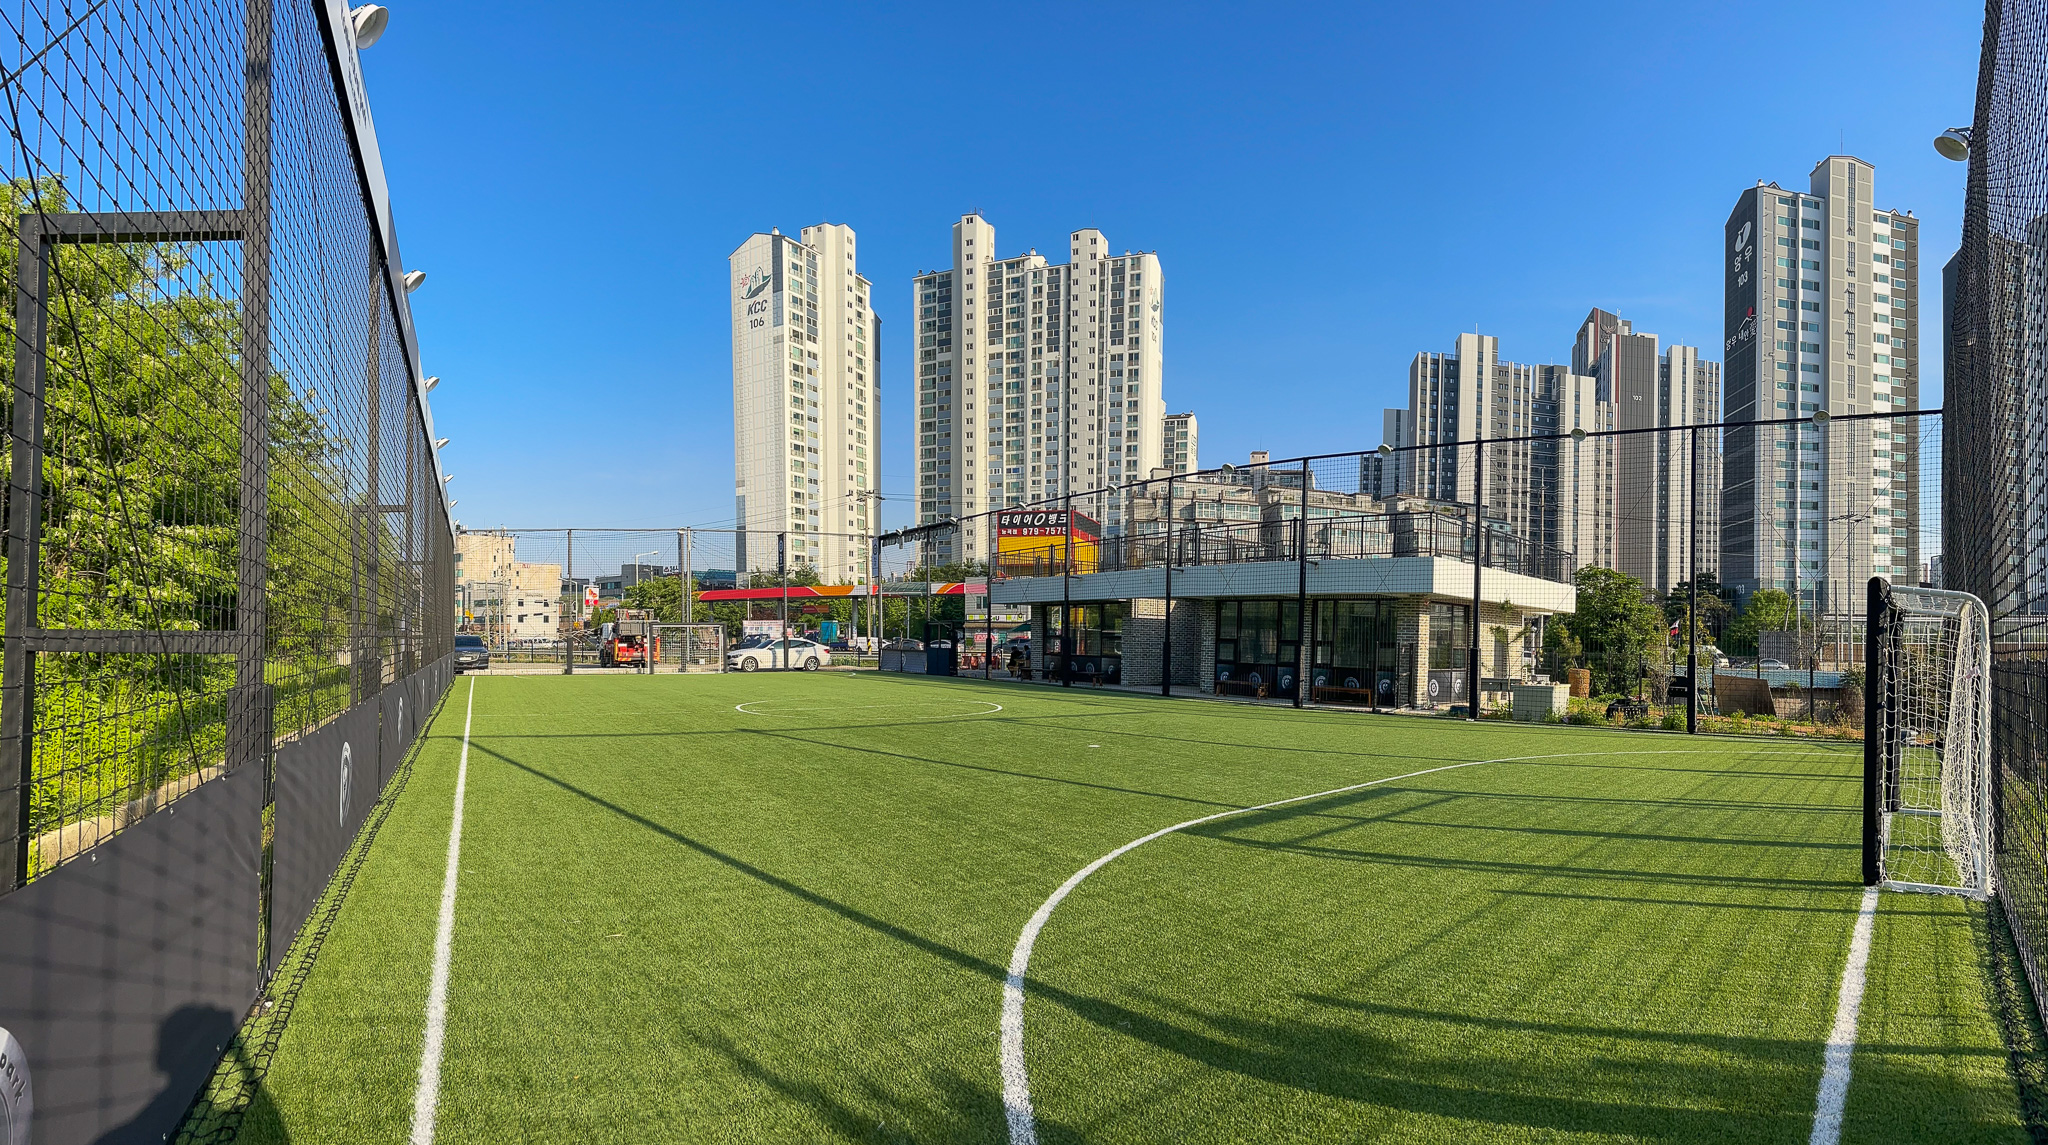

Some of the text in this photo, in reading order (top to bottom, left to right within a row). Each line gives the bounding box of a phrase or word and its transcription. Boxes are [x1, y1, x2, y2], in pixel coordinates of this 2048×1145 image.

[1734, 245, 1753, 272] 양우
[1738, 271, 1748, 287] 103
[747, 299, 768, 316] KCC
[749, 317, 765, 329] 106
[1726, 336, 1736, 350] 양우
